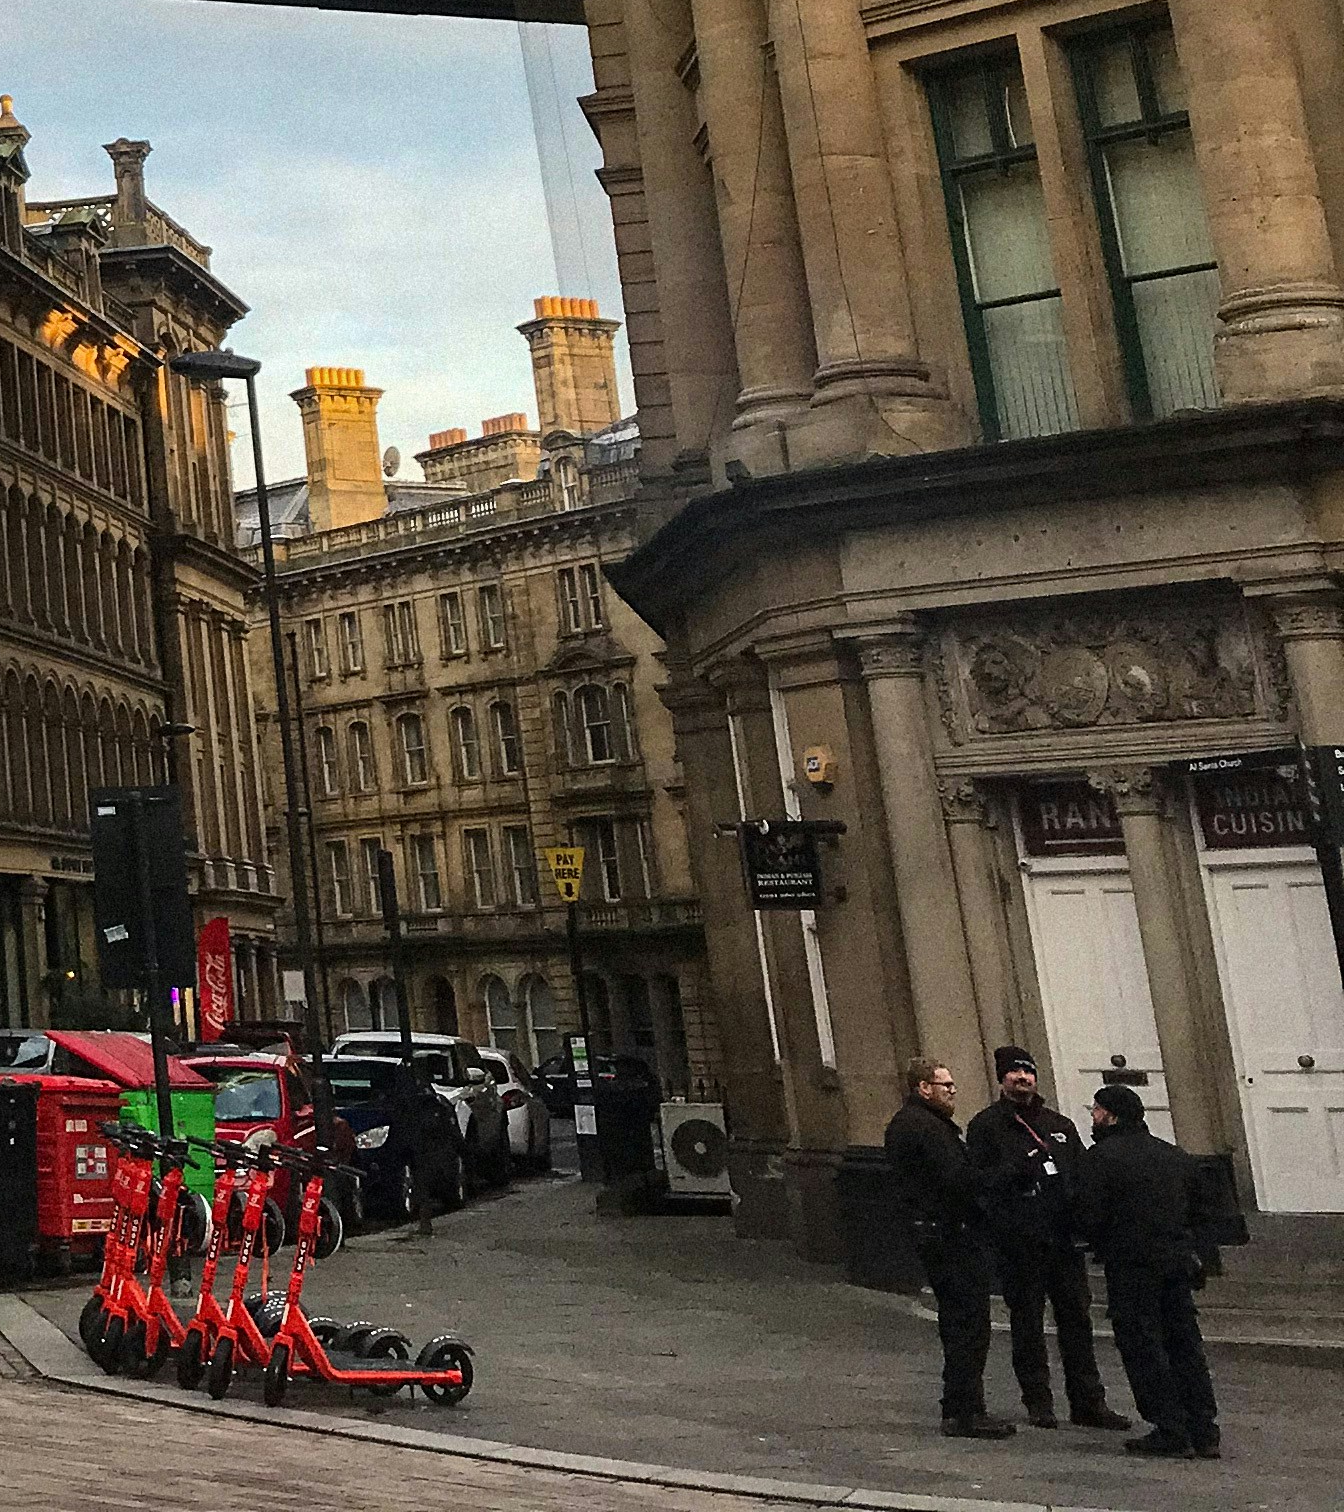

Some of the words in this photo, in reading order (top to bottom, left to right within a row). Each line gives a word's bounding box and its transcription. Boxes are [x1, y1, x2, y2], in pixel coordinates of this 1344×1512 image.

[1218, 758, 1242, 768] Church
[1213, 810, 1306, 835] CUISIN
[556, 854, 575, 866] PAY
[555, 868, 580, 879] HERE
[757, 879, 813, 887] RESTAURANT
